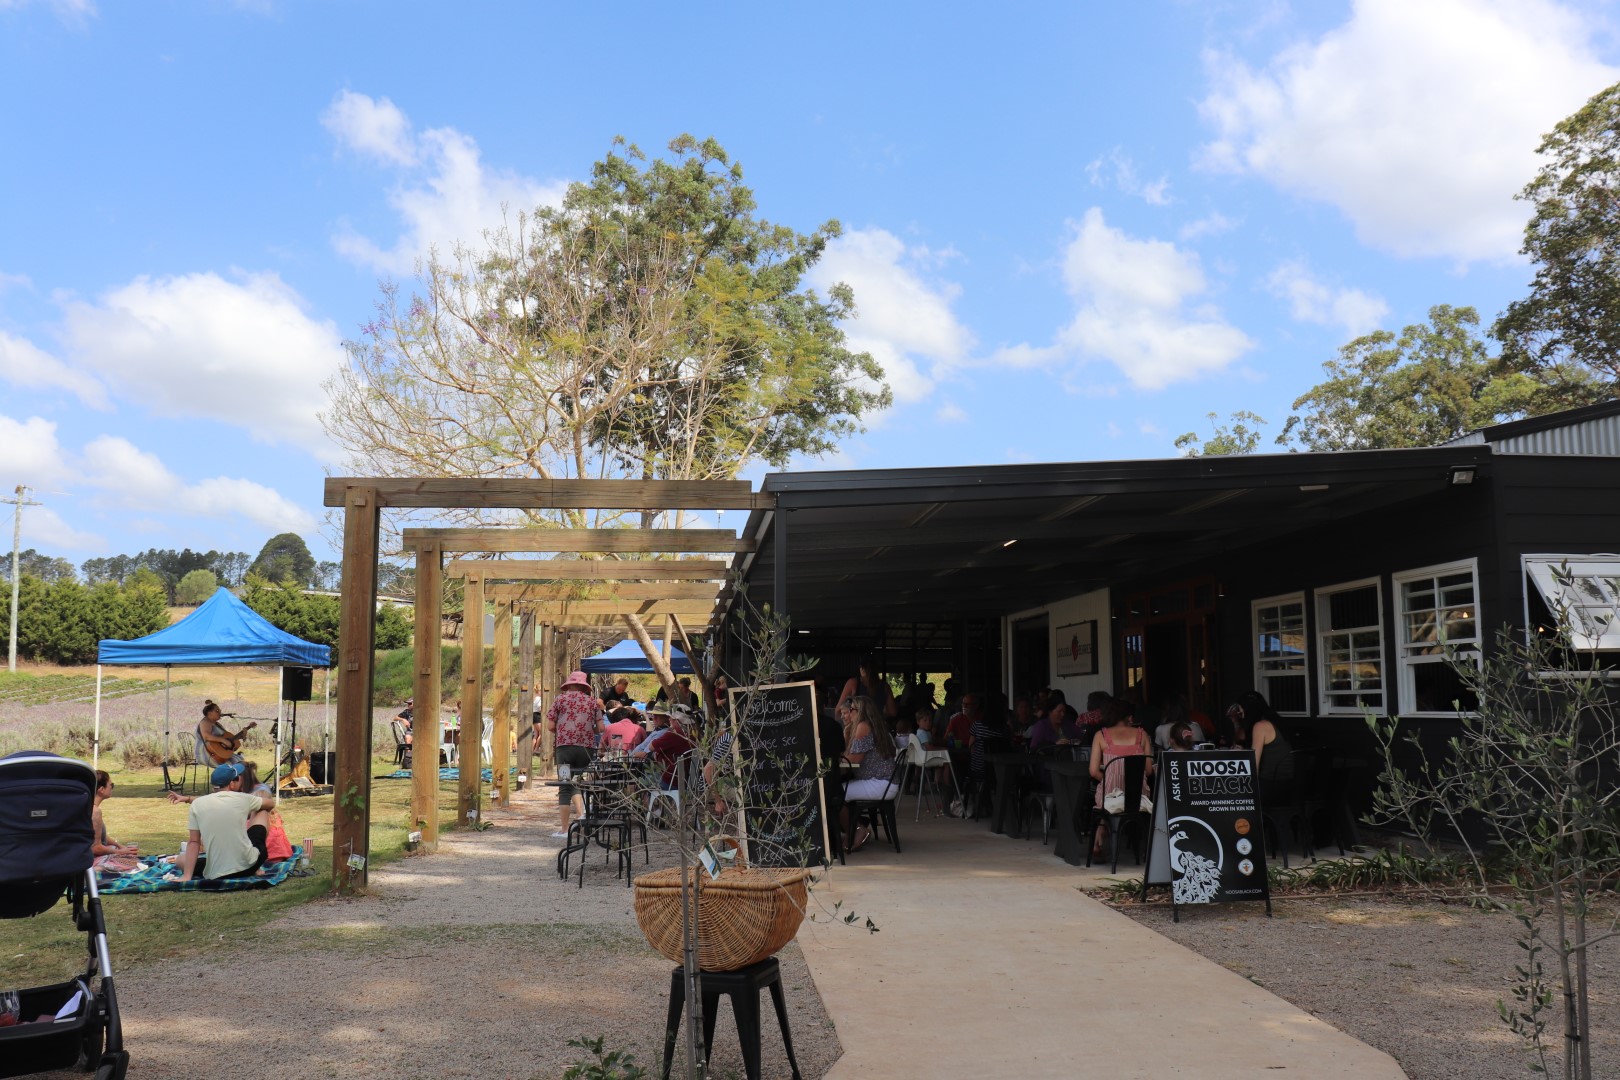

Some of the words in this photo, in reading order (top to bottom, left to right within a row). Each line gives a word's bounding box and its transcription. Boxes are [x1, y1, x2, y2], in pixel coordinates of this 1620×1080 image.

[781, 736, 798, 747] see
[770, 751, 793, 769] sff
[1190, 761, 1248, 776] NOOSA
[1170, 760, 1181, 780] FOR
[1173, 782, 1182, 802] ASK
[1188, 776, 1254, 795] BLACK
